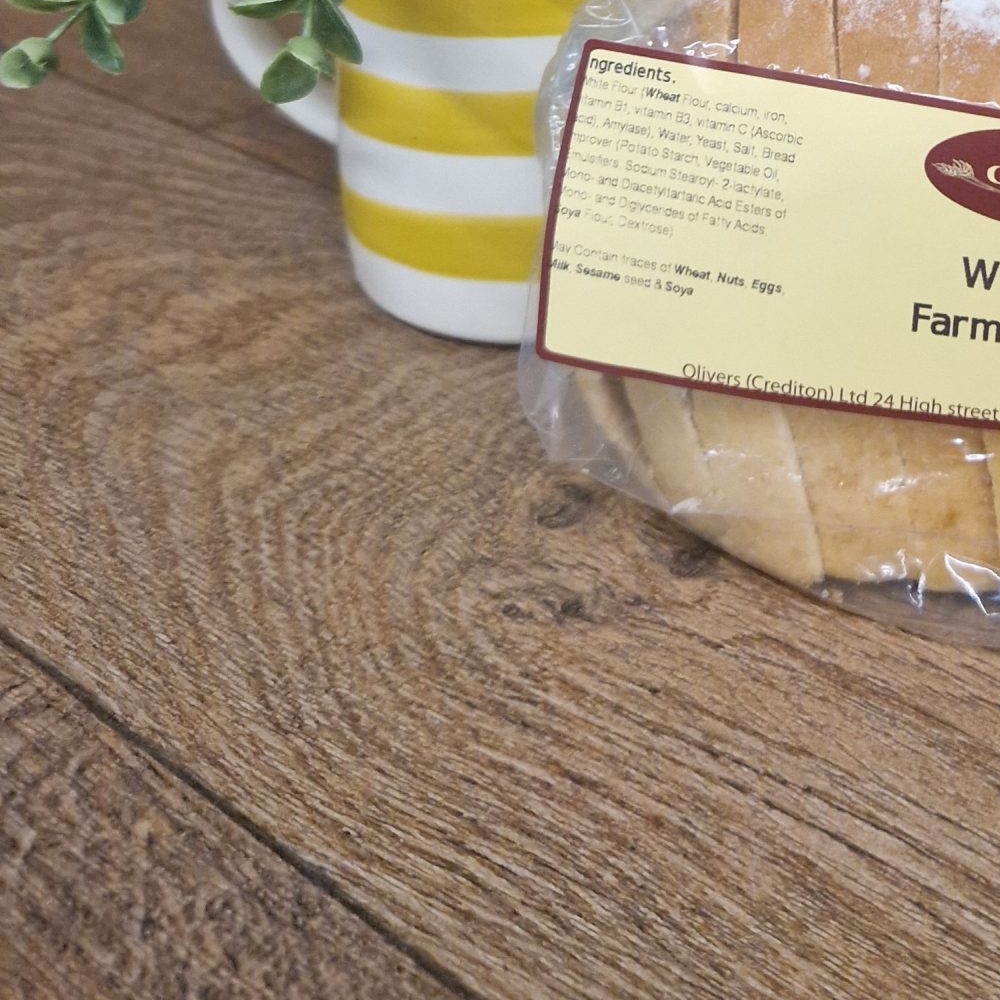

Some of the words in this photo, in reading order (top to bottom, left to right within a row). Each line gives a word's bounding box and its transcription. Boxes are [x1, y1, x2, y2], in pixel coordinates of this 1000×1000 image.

[589, 58, 676, 84] ngredients.
[611, 80, 637, 95] Flour
[641, 86, 680, 104] (Wheat
[682, 93, 711, 111] Flour,
[715, 101, 759, 120] calcium,
[764, 111, 788, 125] iron,
[576, 114, 599, 129] cid),
[658, 127, 692, 147] Water,
[697, 134, 729, 153] Yeast,
[733, 141, 758, 159] Salt,
[762, 146, 796, 163] Bread
[615, 100, 630, 115] B1,
[634, 105, 673, 120] vitamin
[696, 117, 735, 132] vitamin
[739, 123, 748, 135] C
[751, 126, 804, 146] (Ascorbic
[616, 138, 659, 157] (Potato
[662, 147, 700, 167] Starch,
[705, 155, 760, 177] Vegetable
[625, 159, 667, 177] Sodium
[594, 193, 616, 206] and
[688, 211, 699, 222] of
[702, 212, 732, 230] Fatty
[598, 175, 618, 187] and
[707, 195, 732, 210] Acid
[735, 200, 772, 218] Esters
[775, 208, 787, 220] of
[558, 204, 581, 219] oya
[618, 214, 674, 238] Dextrose)
[574, 243, 618, 262] Contain
[622, 254, 657, 271] traces
[659, 262, 672, 273] of
[575, 263, 621, 282] Sesame
[624, 274, 652, 288] seed
[654, 278, 663, 290] &
[664, 280, 694, 297] Soya
[682, 362, 741, 387] Olivers
[746, 373, 834, 402] (Crediton)
[839, 387, 868, 406] Ltd
[873, 391, 895, 409] 24
[899, 394, 942, 415] High
[948, 401, 999, 422] street
